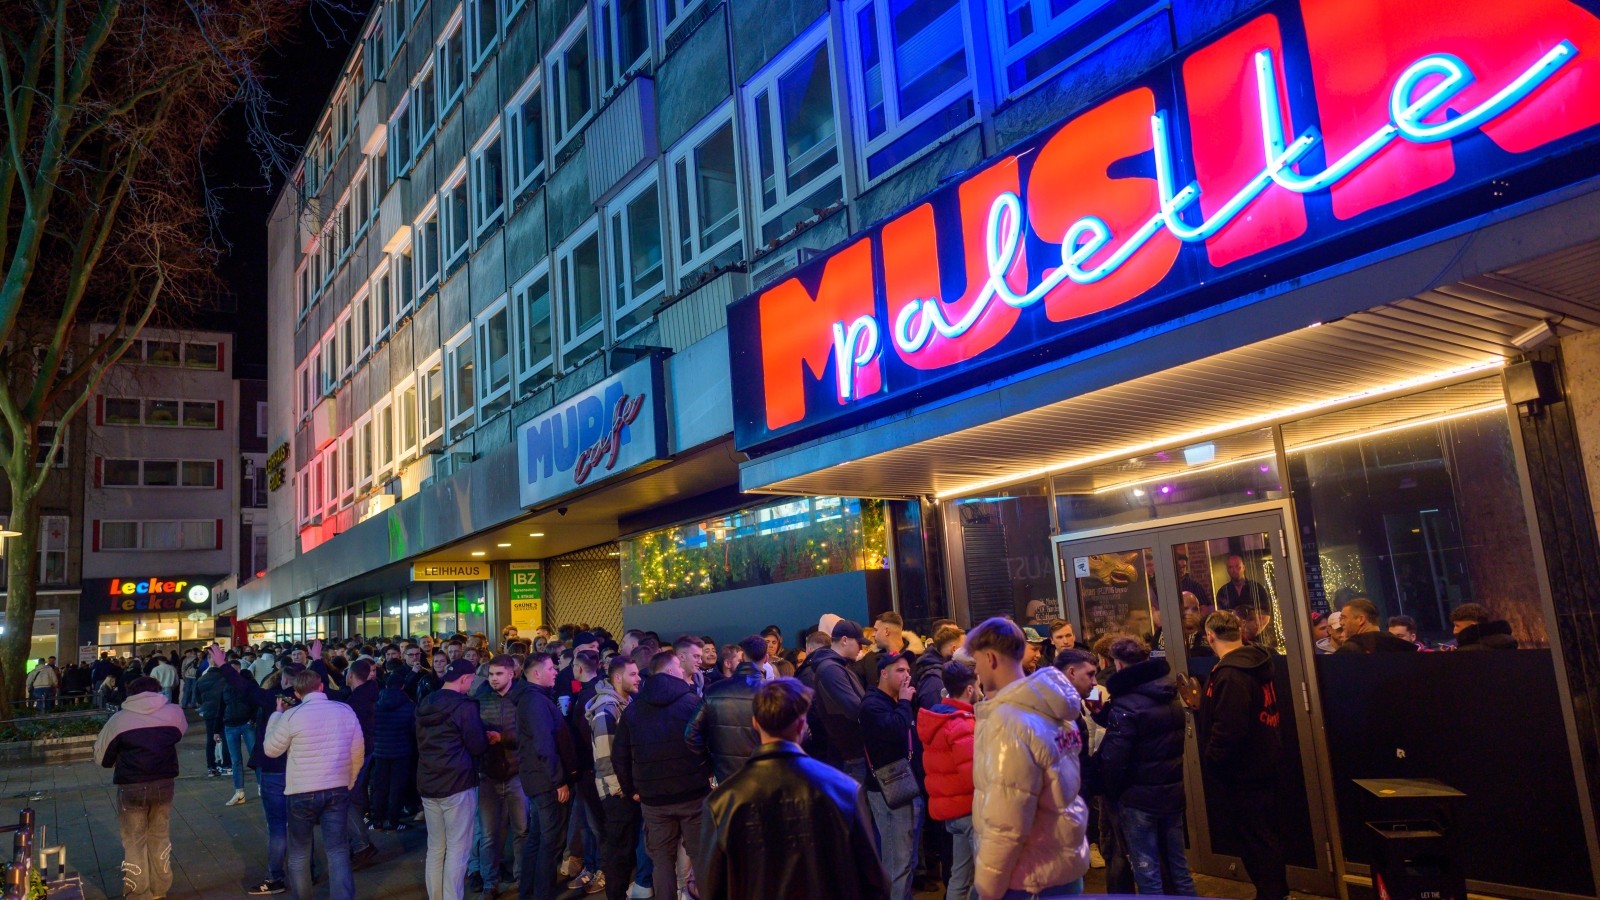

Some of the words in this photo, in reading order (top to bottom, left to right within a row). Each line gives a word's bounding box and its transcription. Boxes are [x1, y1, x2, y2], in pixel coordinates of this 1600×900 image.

[832, 37, 1580, 402] palette
[425, 566, 480, 576] LEIHHAUS
[109, 577, 188, 596] Lecker
[513, 573, 536, 585] IBZ
